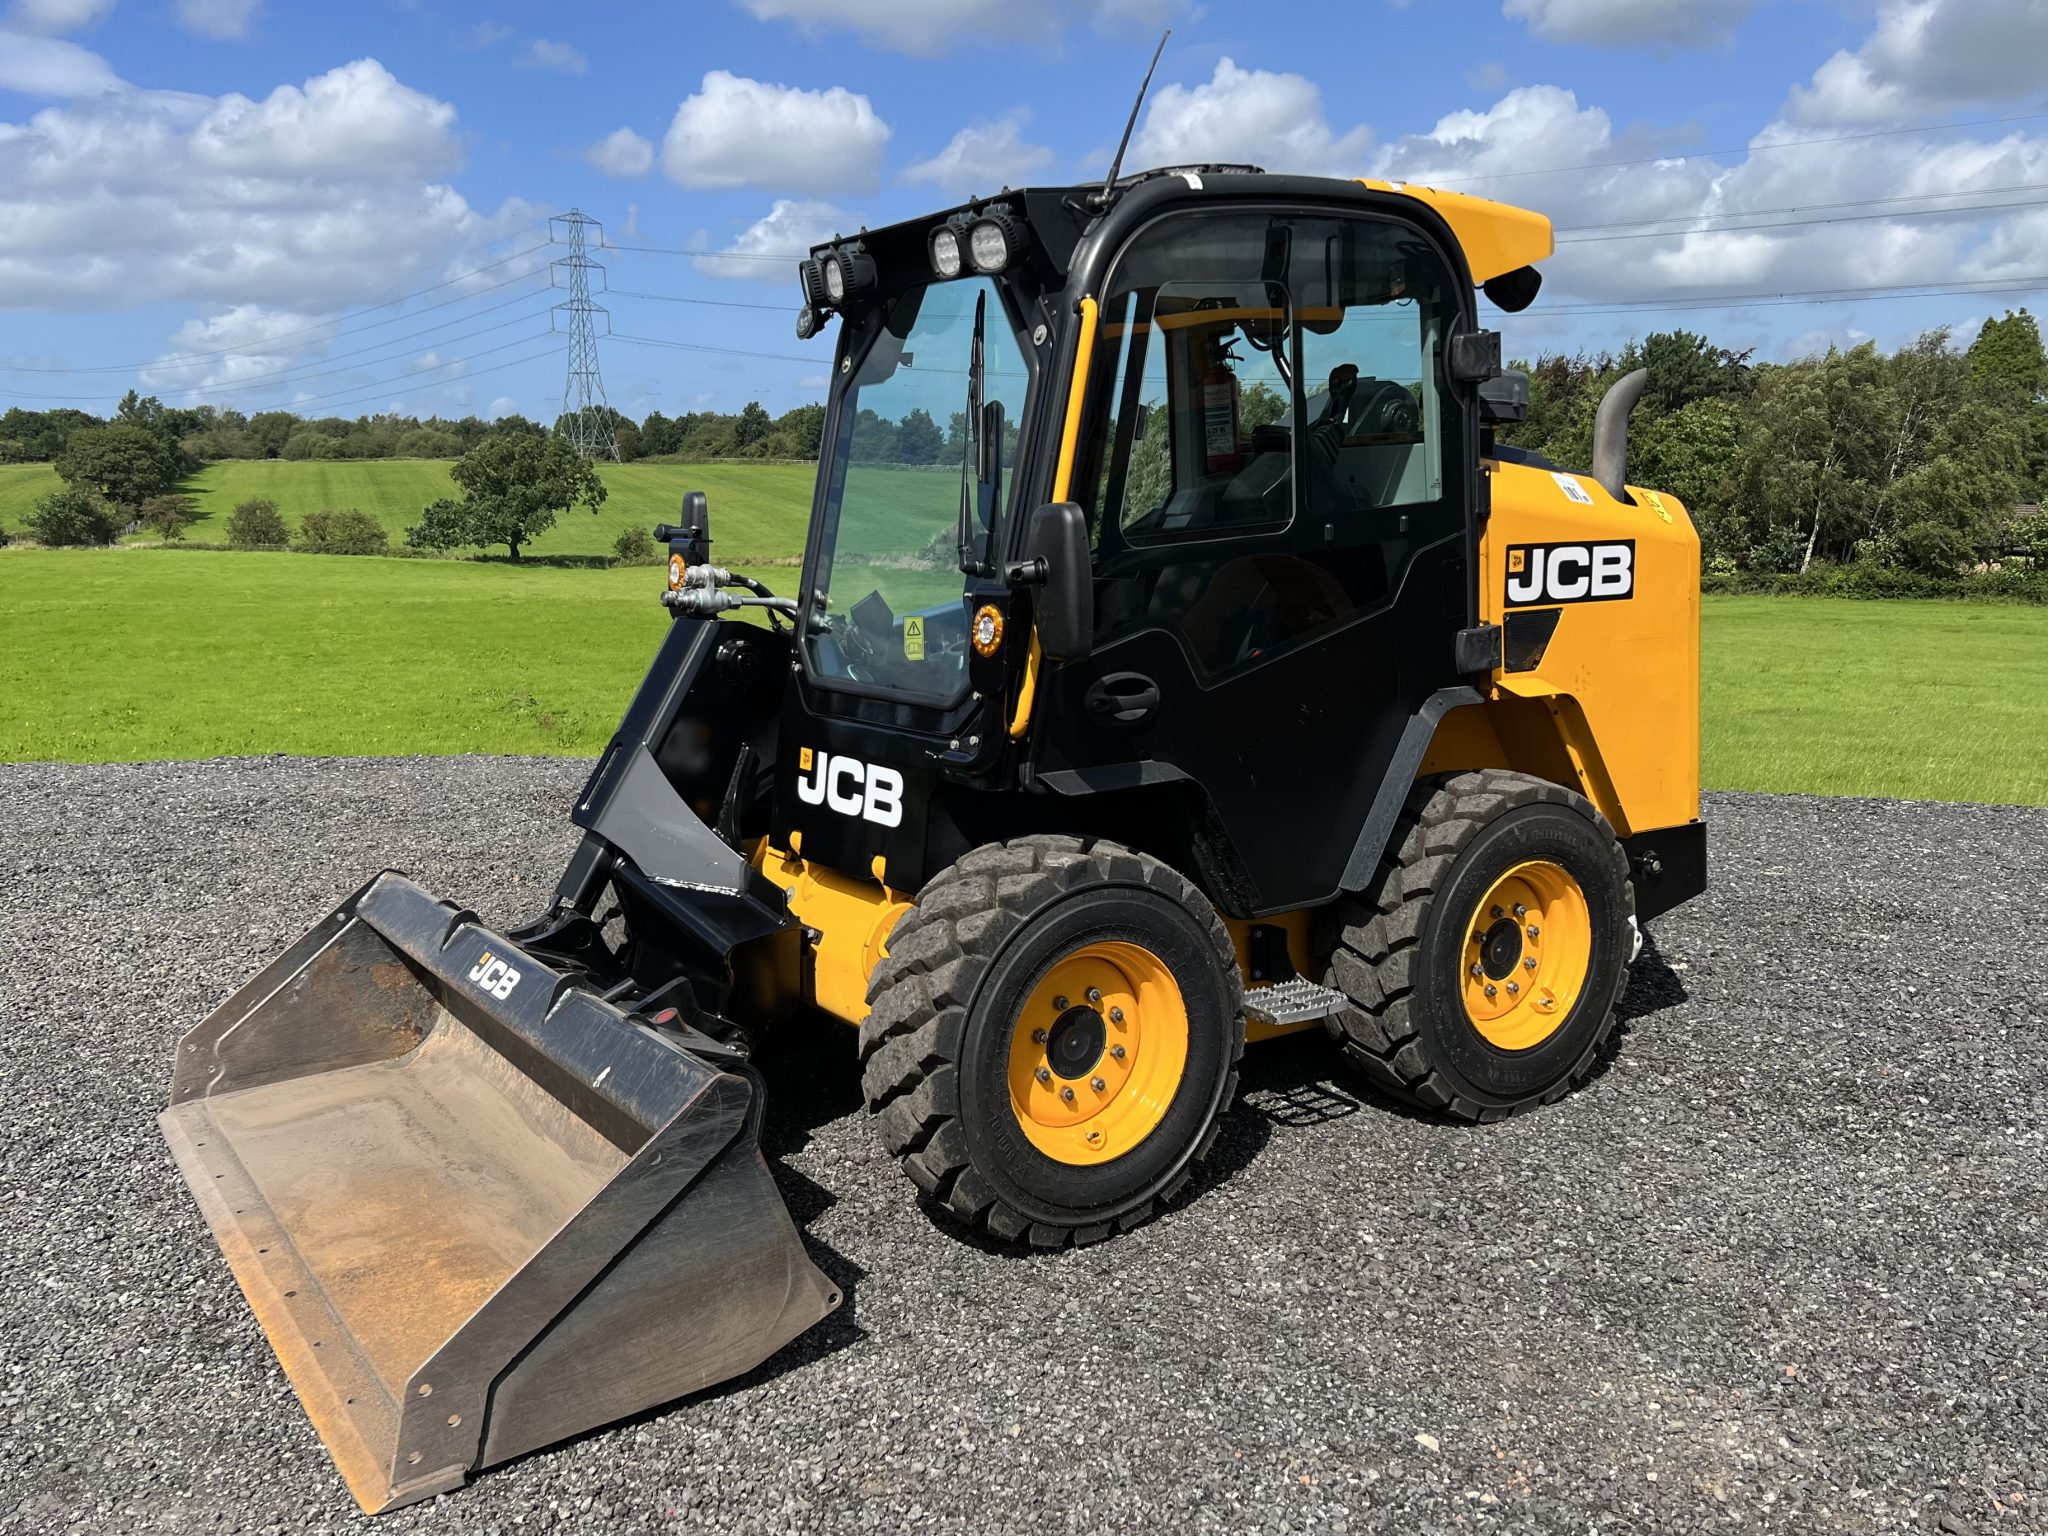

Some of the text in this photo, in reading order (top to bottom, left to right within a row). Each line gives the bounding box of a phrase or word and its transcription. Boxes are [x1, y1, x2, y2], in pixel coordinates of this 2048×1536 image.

[1507, 545, 1632, 602] JCB
[797, 750, 904, 828] JCB
[468, 955, 522, 1001] JCB
